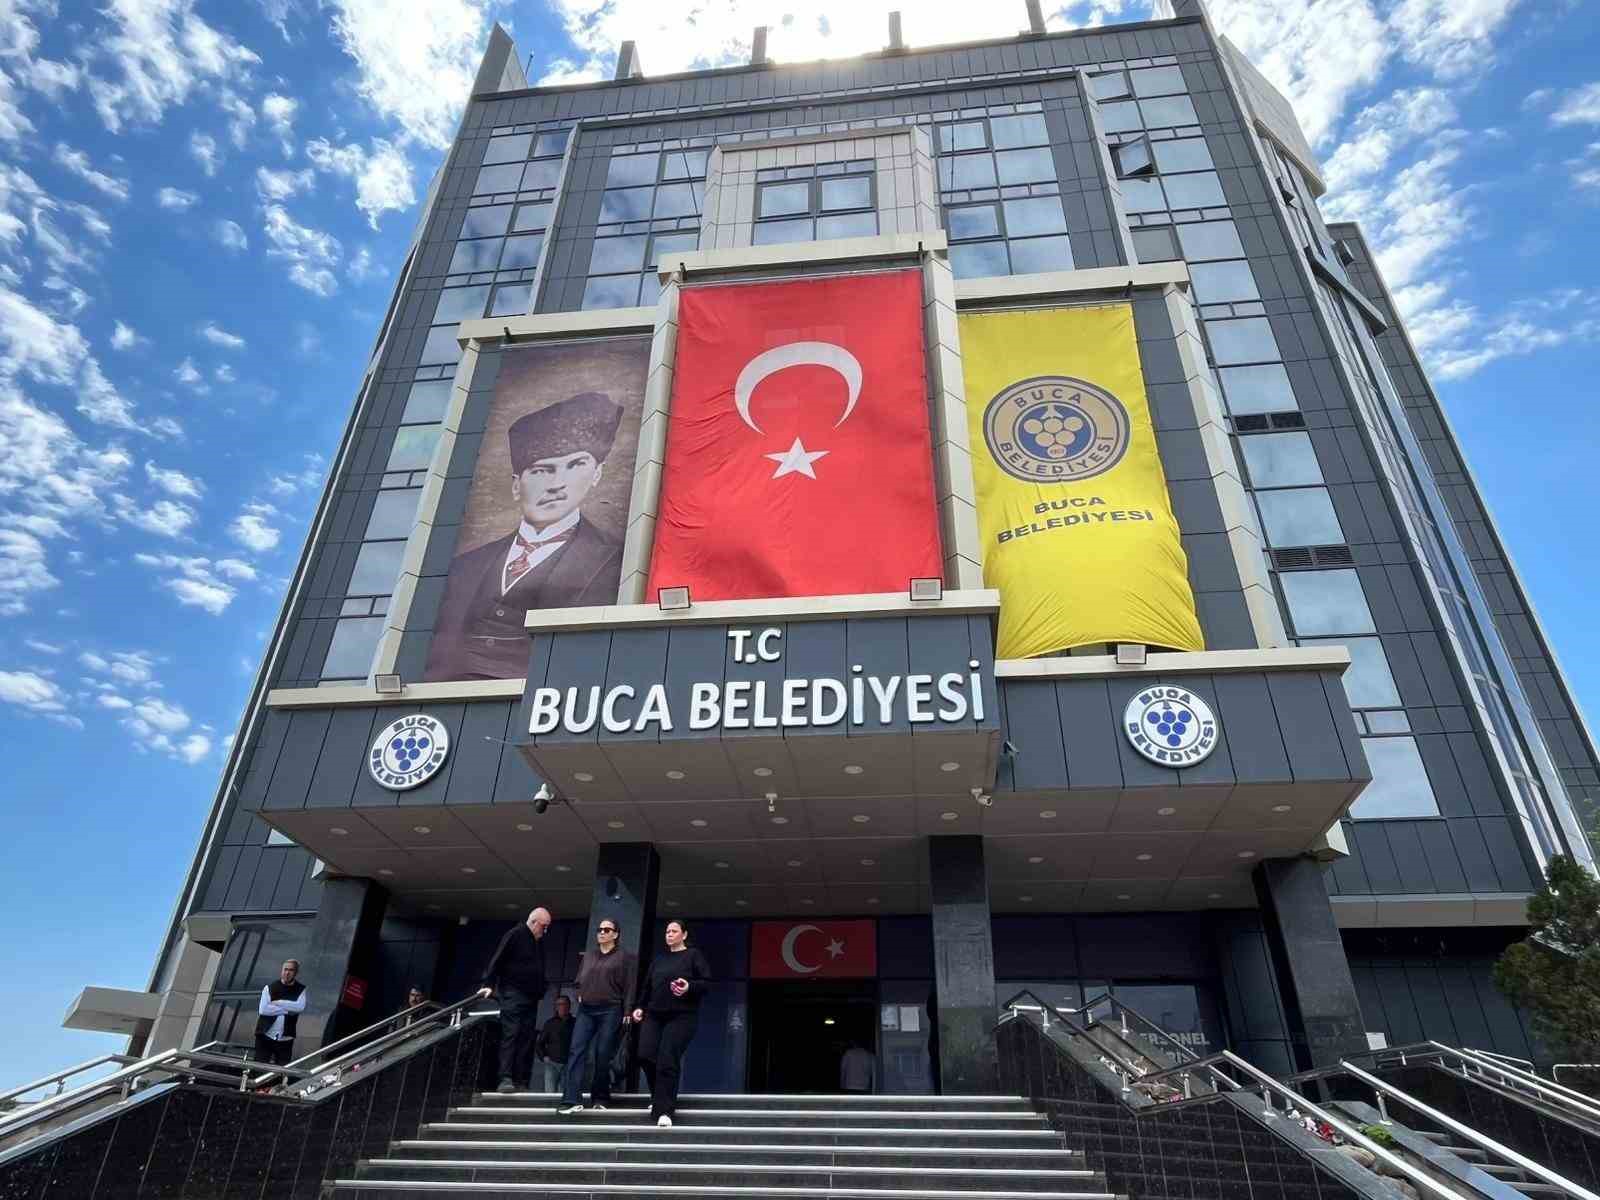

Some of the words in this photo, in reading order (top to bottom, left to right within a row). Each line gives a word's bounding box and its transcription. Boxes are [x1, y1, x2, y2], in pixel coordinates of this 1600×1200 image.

[1014, 388, 1082, 408] BUCA
[1000, 436, 1114, 475] BELEDİYESİ
[1034, 496, 1106, 514] BUCA
[997, 509, 1154, 544] BELEDİYESİ
[727, 627, 782, 663] T.C
[528, 683, 673, 734] BUCA
[689, 660, 985, 730] BELEDİYESİ
[1139, 689, 1191, 705] BUCA
[392, 717, 437, 732] BUCA
